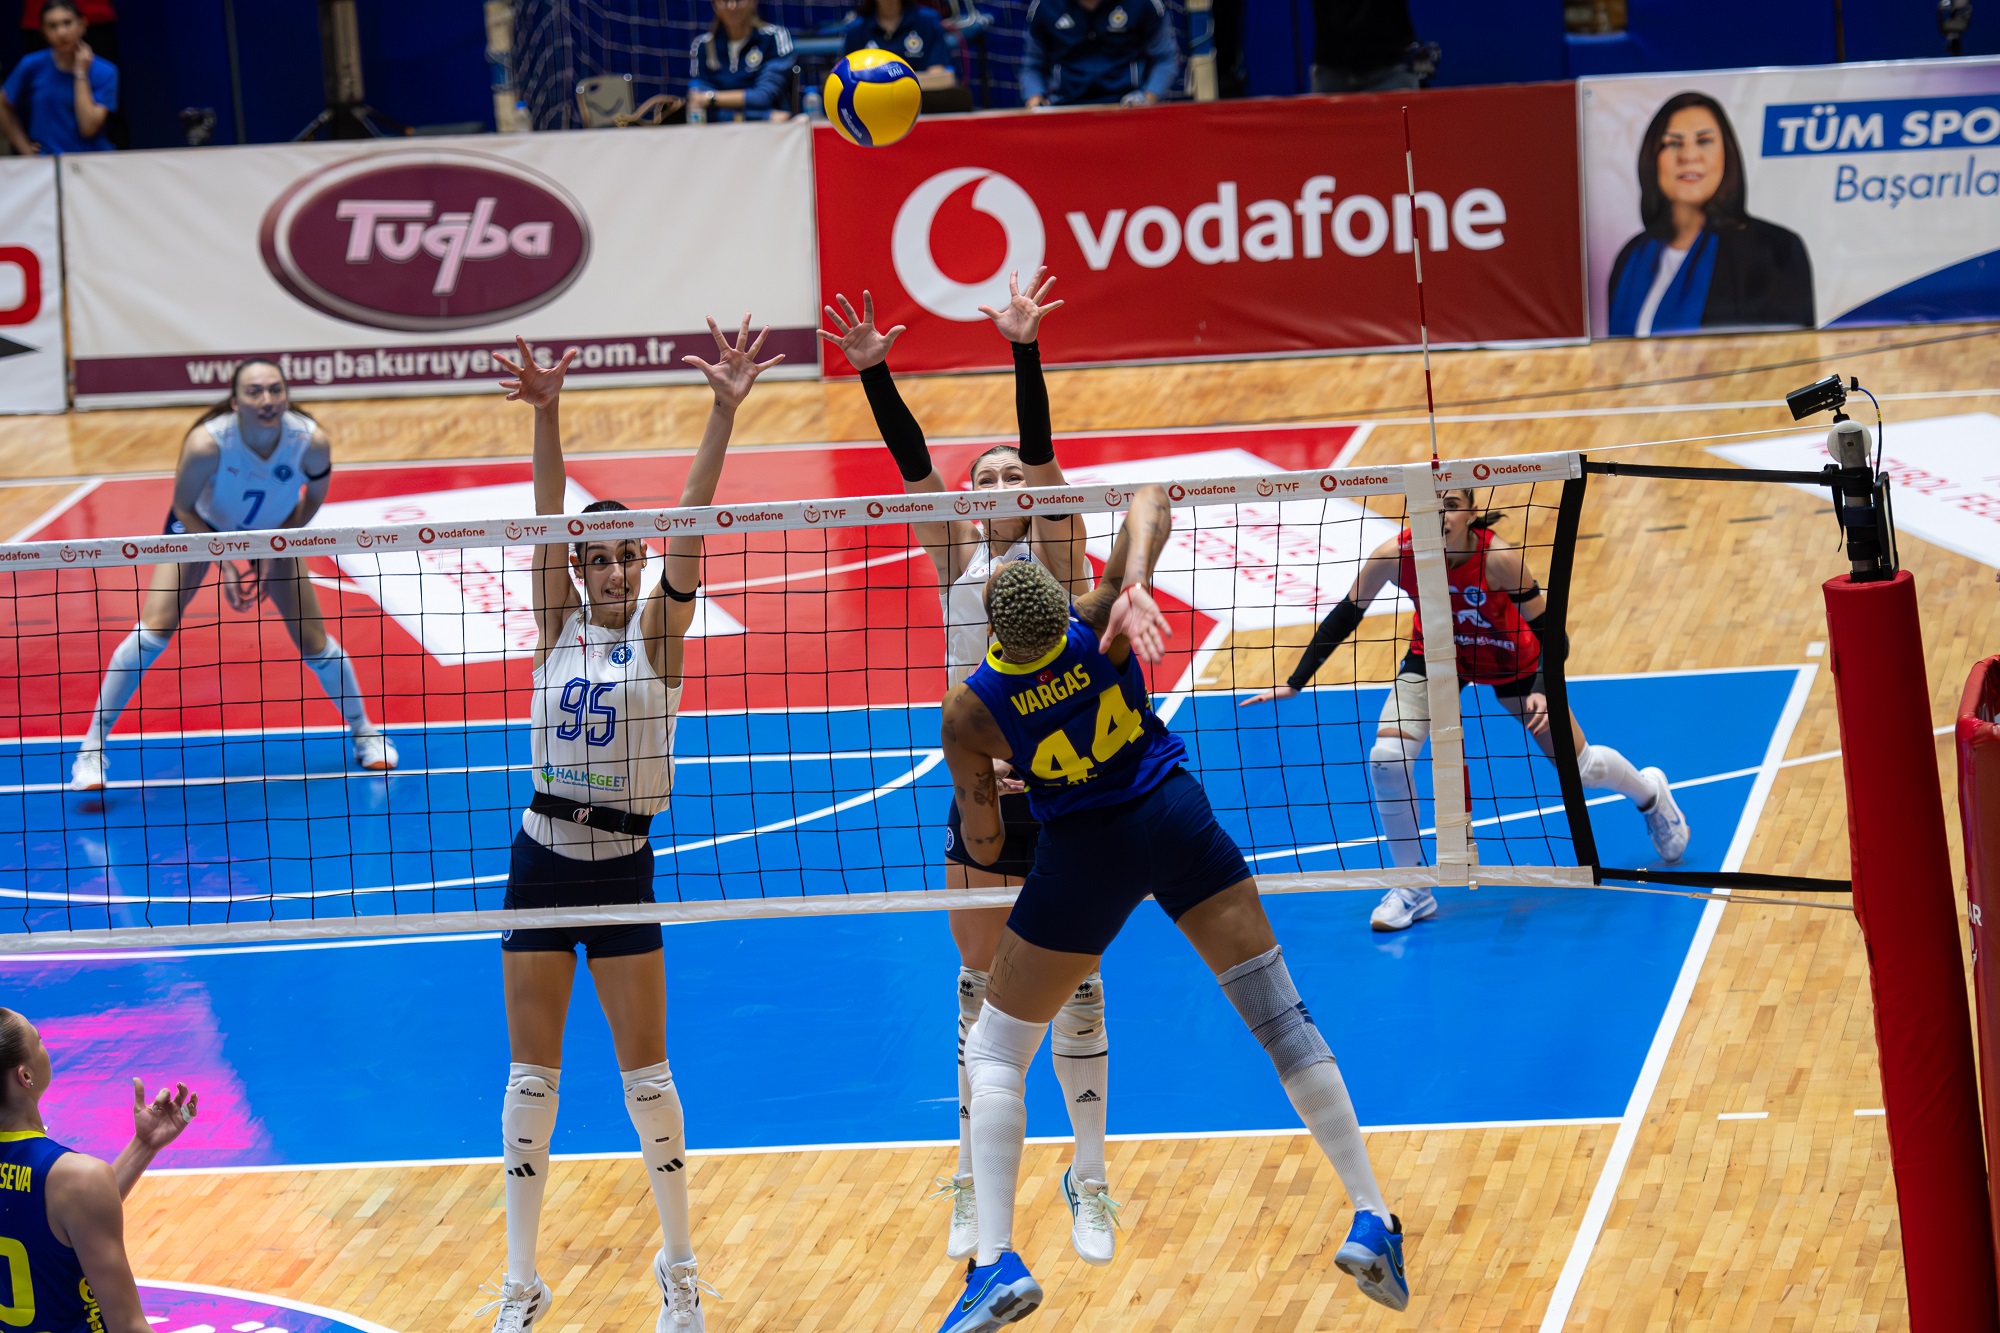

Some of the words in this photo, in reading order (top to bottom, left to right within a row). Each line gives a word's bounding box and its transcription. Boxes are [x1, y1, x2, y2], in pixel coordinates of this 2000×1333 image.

[1778, 104, 1885, 152] TÜM
[1899, 106, 2000, 147] SPO
[1065, 174, 1507, 271] vodafone
[1492, 463, 1542, 476] vodafone
[1338, 474, 1389, 487] vodafone
[1186, 484, 1237, 497] vodafone
[1275, 481, 1300, 493] TVF
[972, 499, 998, 511] TVF
[1035, 493, 1085, 505] vodafone
[241, 489, 267, 525] 7
[885, 502, 935, 514] vodafone
[735, 511, 784, 523] vodafone
[821, 508, 847, 520] TVF
[586, 519, 635, 531] vodafone
[672, 517, 697, 528] TVF
[437, 527, 486, 539] vodafone
[523, 525, 548, 537] TVF
[288, 536, 337, 547] vodafone
[374, 534, 399, 545] TVF
[140, 543, 189, 554] vodafone
[226, 541, 250, 552] TVF
[78, 548, 102, 560] TVF
[1010, 663, 1092, 716] VARGAS
[555, 676, 617, 748] 95
[1031, 683, 1145, 785] 44
[555, 766, 628, 788] HALKEGEET
